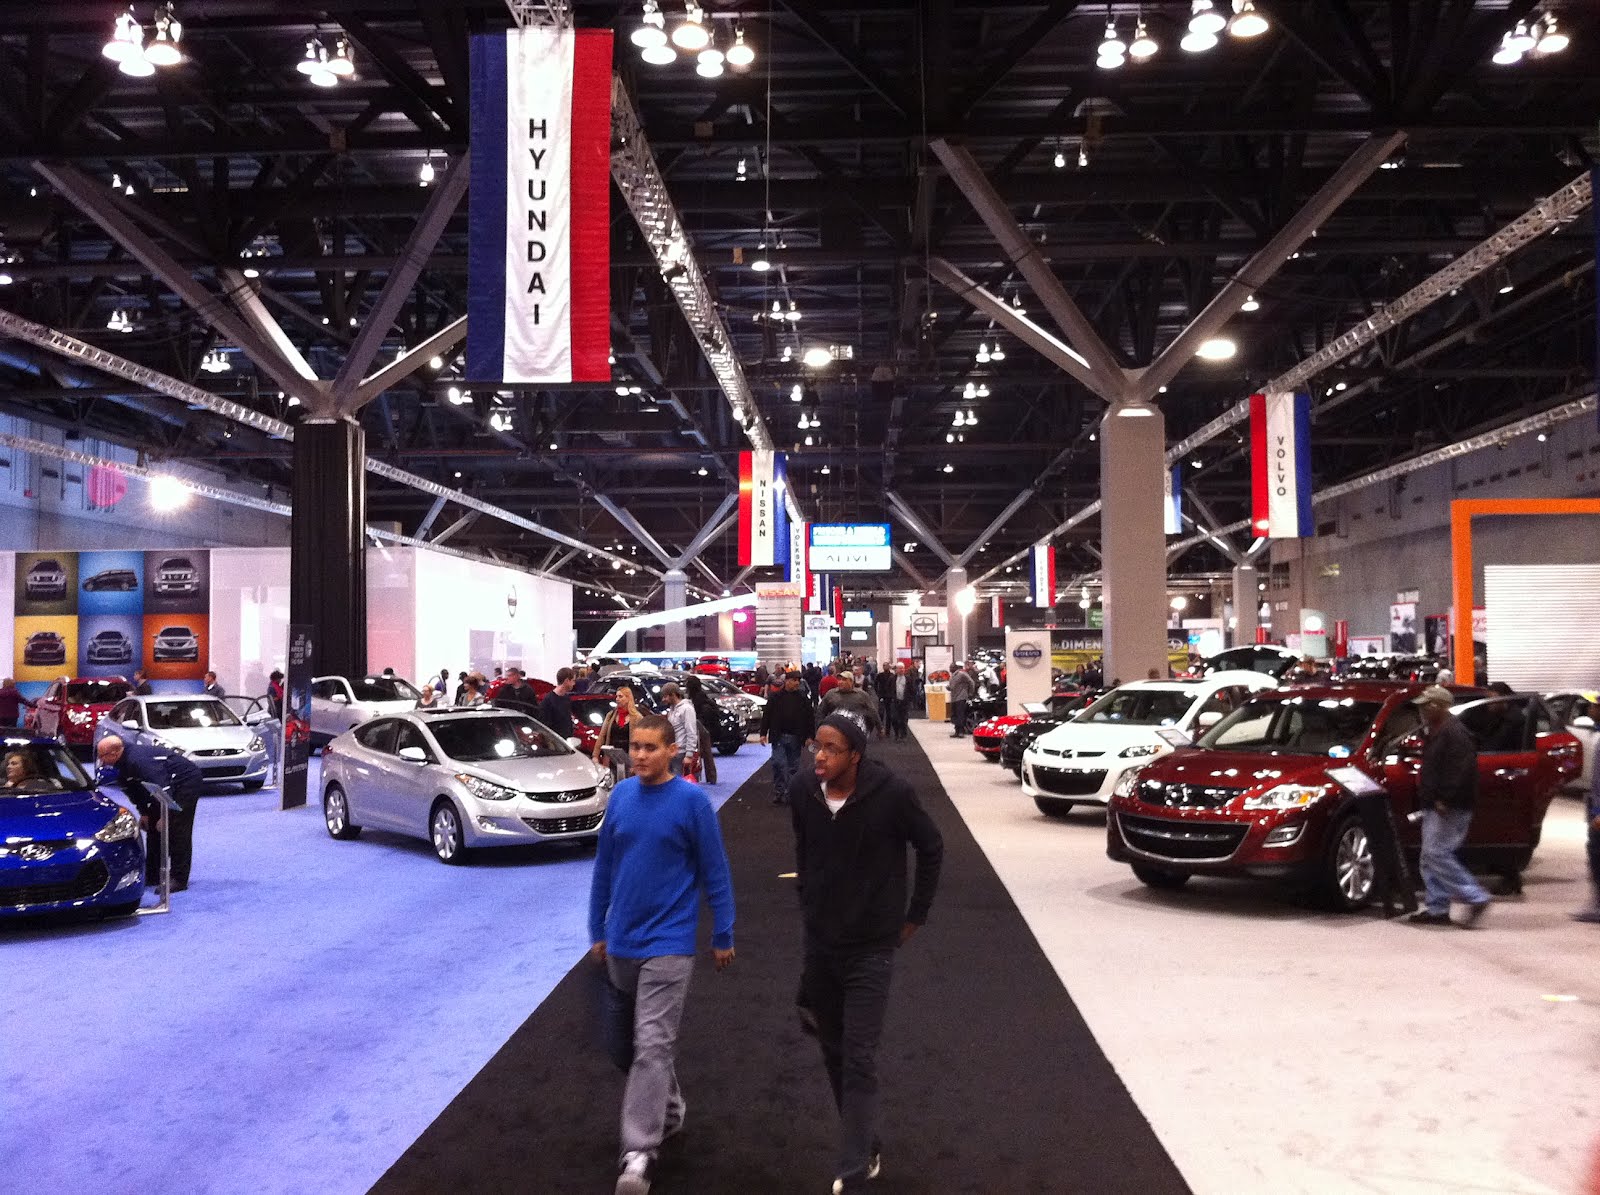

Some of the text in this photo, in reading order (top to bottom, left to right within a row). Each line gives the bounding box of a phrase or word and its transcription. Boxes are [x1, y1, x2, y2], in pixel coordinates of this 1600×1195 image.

[527, 118, 548, 325] HYUNDAI
[1275, 434, 1287, 496] VOLVO
[758, 479, 767, 537] NISSAN
